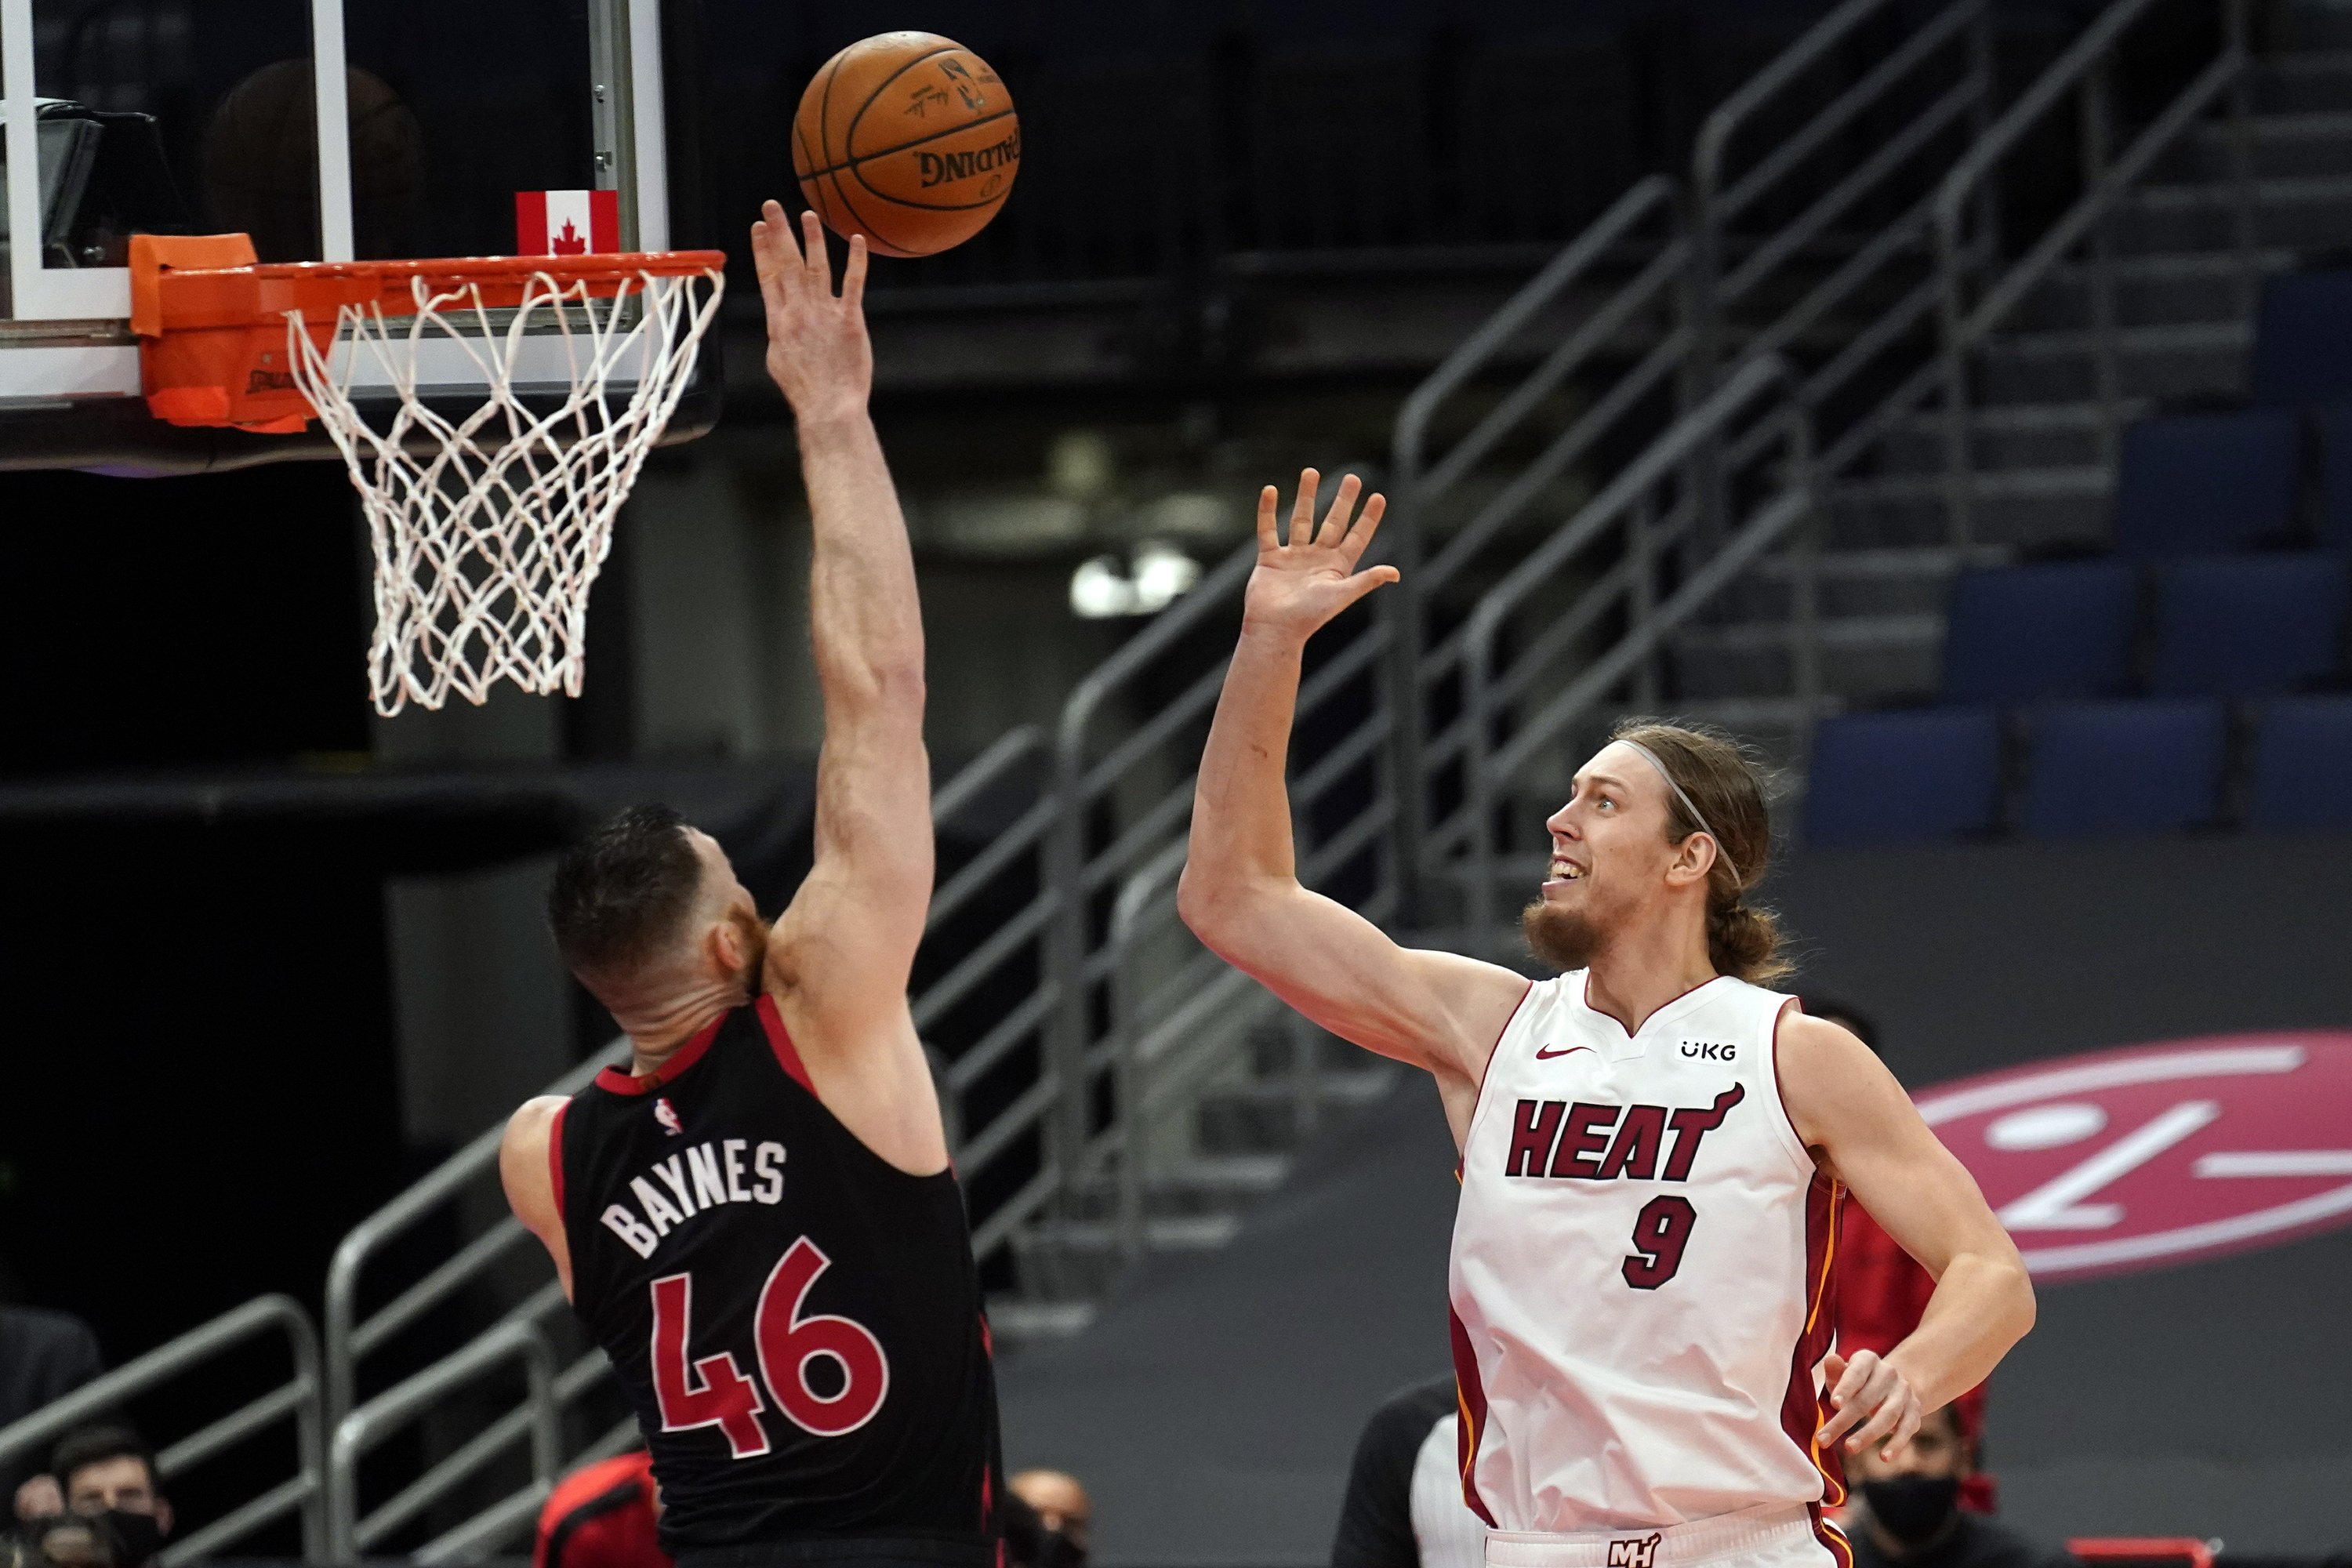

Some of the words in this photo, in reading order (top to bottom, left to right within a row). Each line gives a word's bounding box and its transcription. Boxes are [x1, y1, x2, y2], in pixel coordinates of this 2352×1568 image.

[919, 127, 1021, 189] PALDING
[1504, 1081, 1746, 1182] HEAT
[600, 1138, 788, 1259] BAYNES
[1621, 1194, 1697, 1290] 9
[650, 1234, 890, 1460] 46
